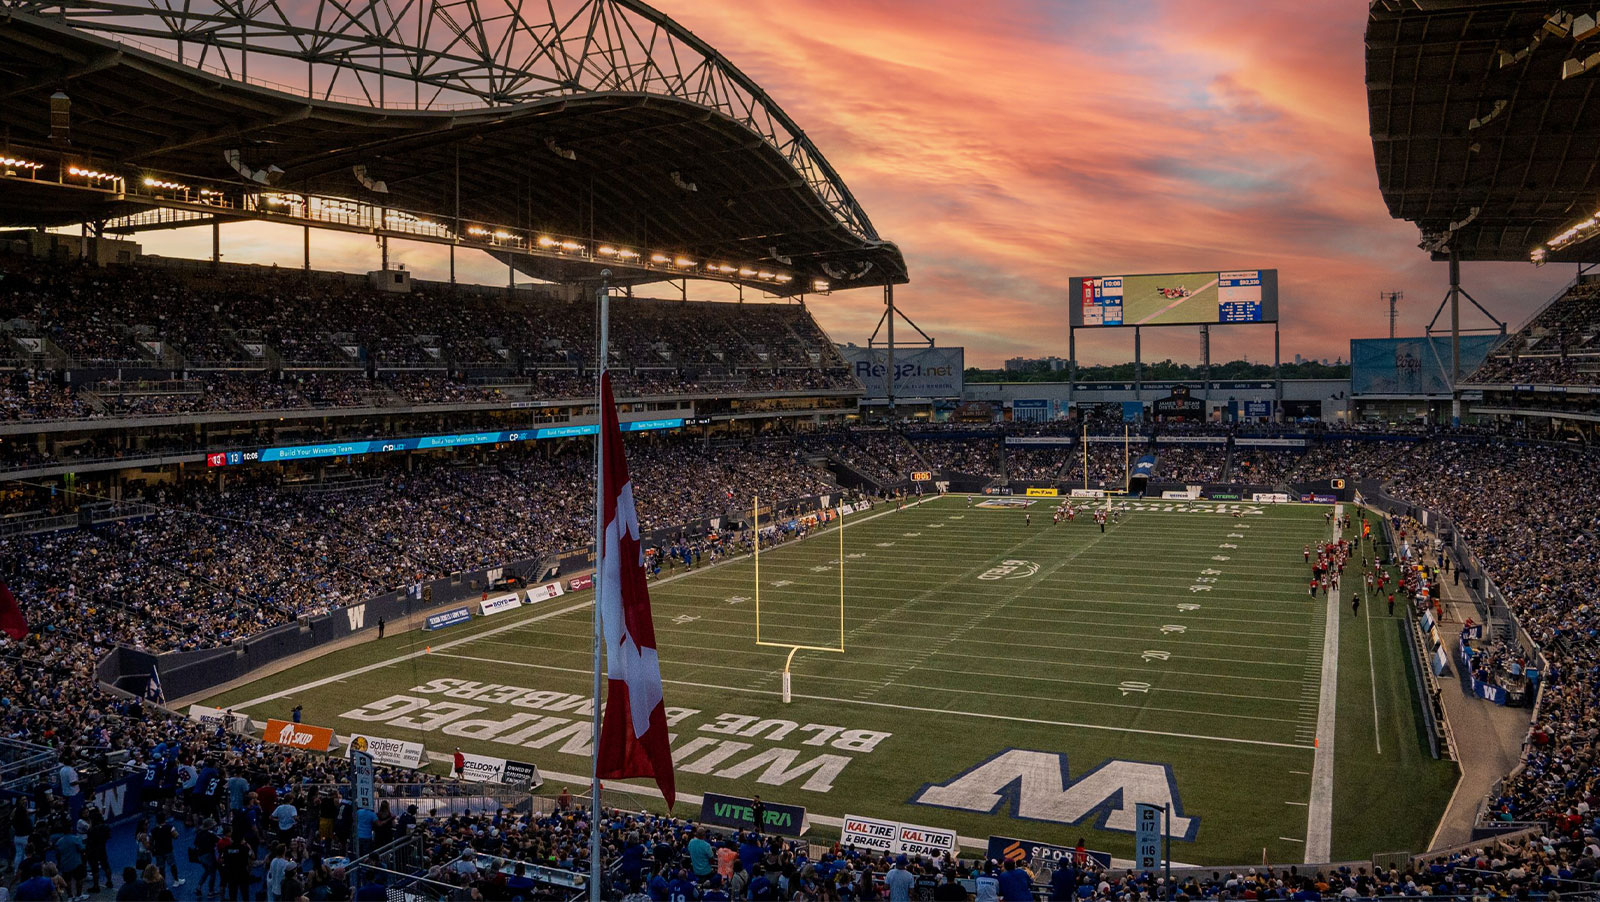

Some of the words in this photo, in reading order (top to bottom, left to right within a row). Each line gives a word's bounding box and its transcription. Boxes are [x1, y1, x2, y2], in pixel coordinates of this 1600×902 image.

[230, 454, 238, 462] 13
[493, 599, 508, 607] BOYD
[347, 604, 366, 631] W
[1483, 684, 1497, 700] W
[292, 732, 313, 744] SKIP
[697, 713, 892, 752] BLUE
[370, 740, 404, 753] sphere1
[464, 761, 493, 772] CELDOR
[916, 748, 1192, 838] W
[95, 784, 126, 820] W
[1142, 822, 1155, 831] 117
[853, 836, 891, 849] BRAKES
[901, 843, 907, 852] &
[909, 845, 949, 858] BRAS
[1031, 846, 1094, 866] SPORS
[1142, 845, 1155, 856] 116
